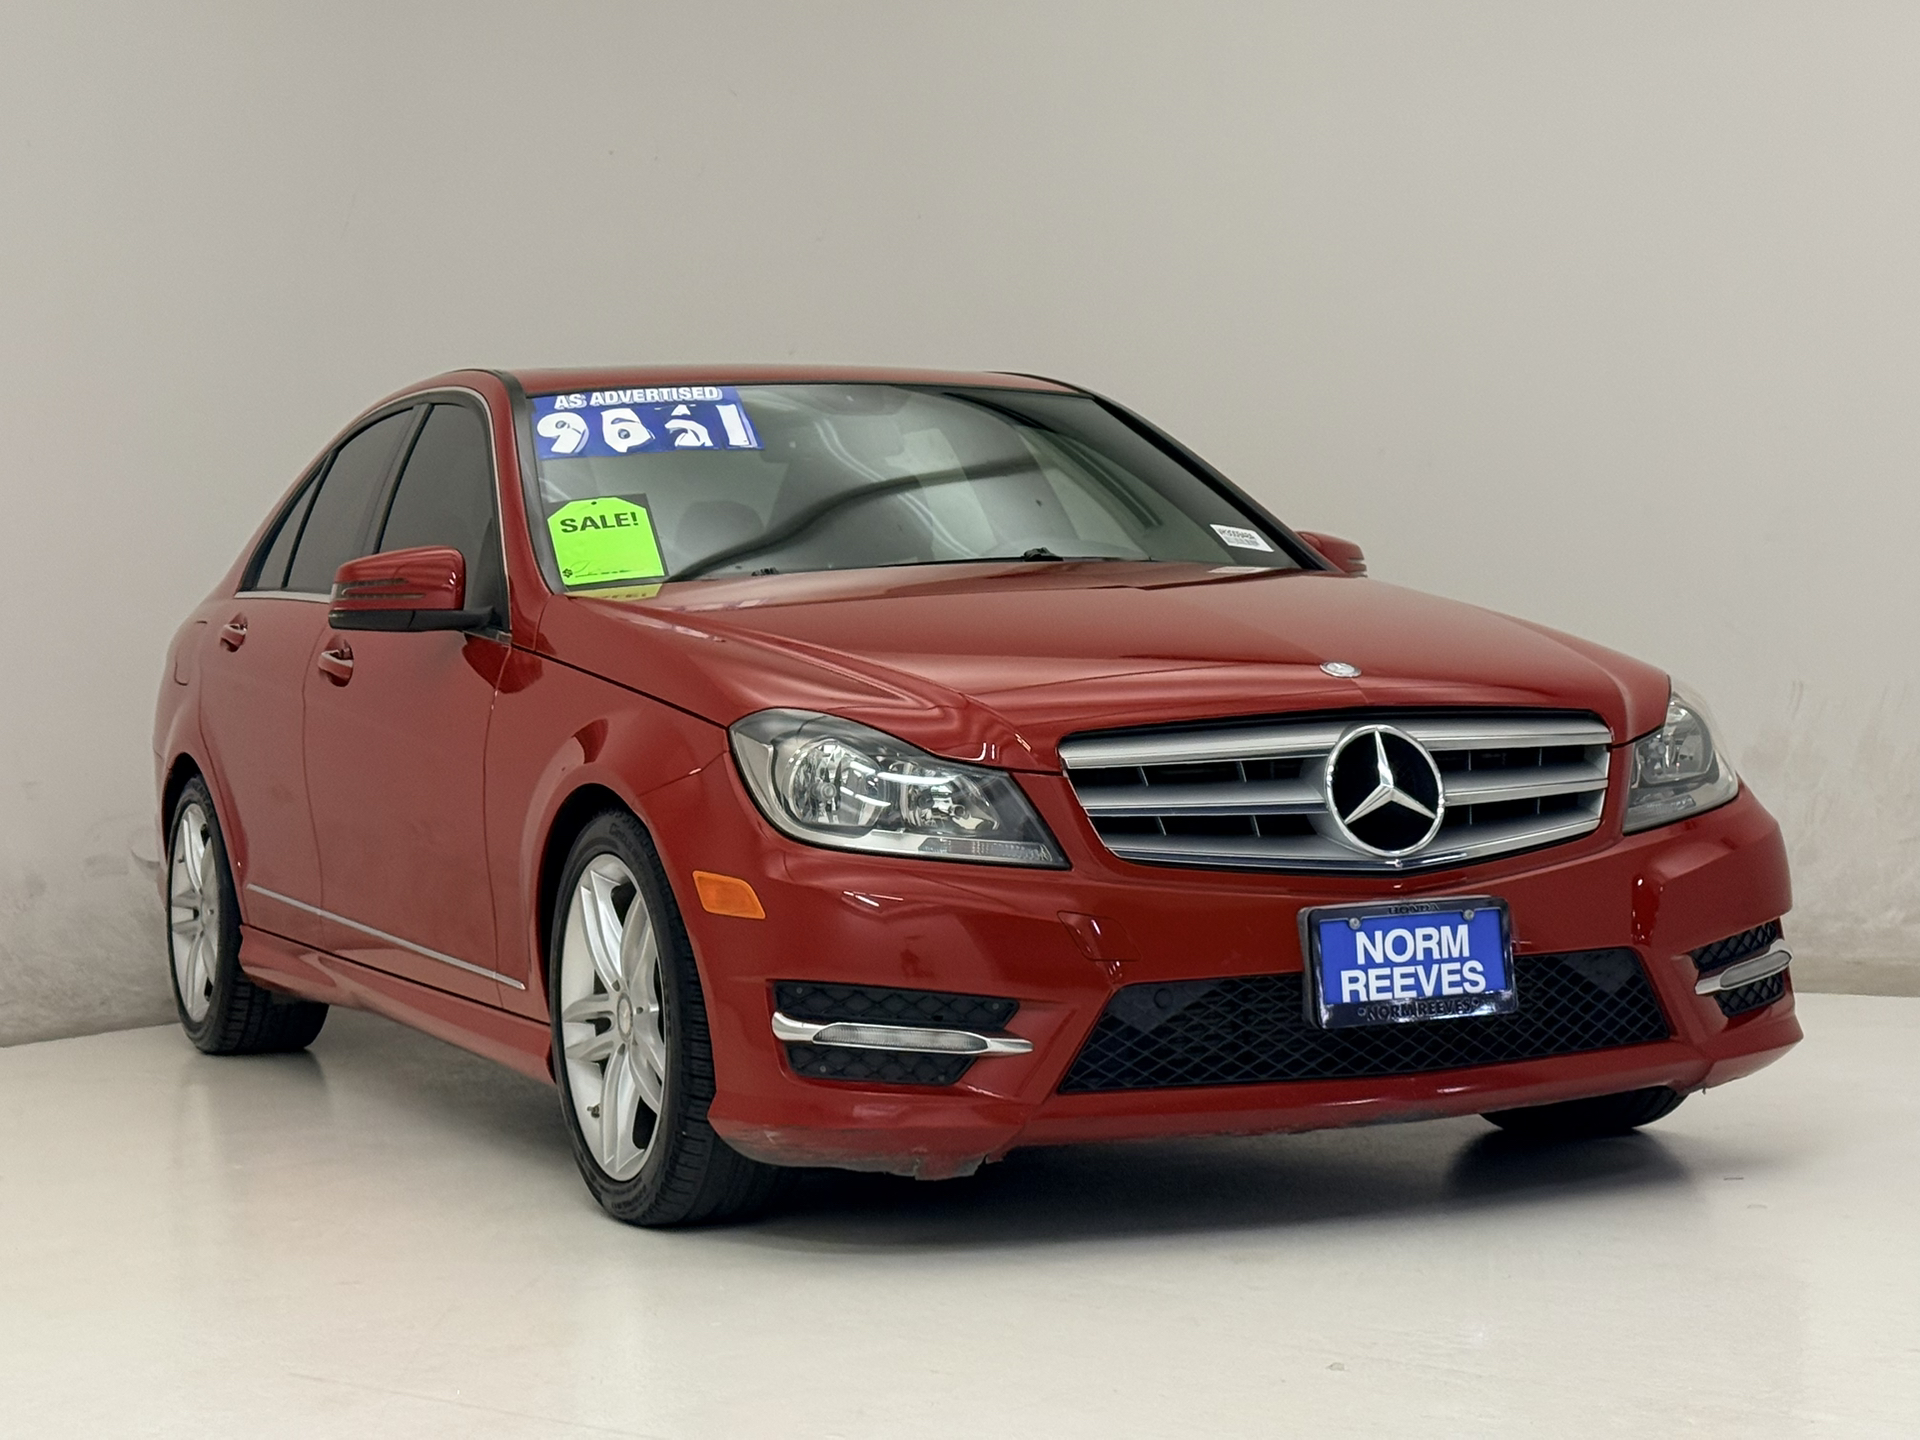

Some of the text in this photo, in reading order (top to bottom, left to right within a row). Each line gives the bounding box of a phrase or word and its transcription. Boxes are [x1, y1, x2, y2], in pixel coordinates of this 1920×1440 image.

[554, 386, 723, 410] AS ADVERTISED
[559, 511, 639, 533] SALE!
[1387, 902, 1440, 915] HONDA
[1355, 923, 1470, 965] NORM
[1340, 960, 1487, 1004] REEVES
[1366, 1001, 1417, 1022] NORM
